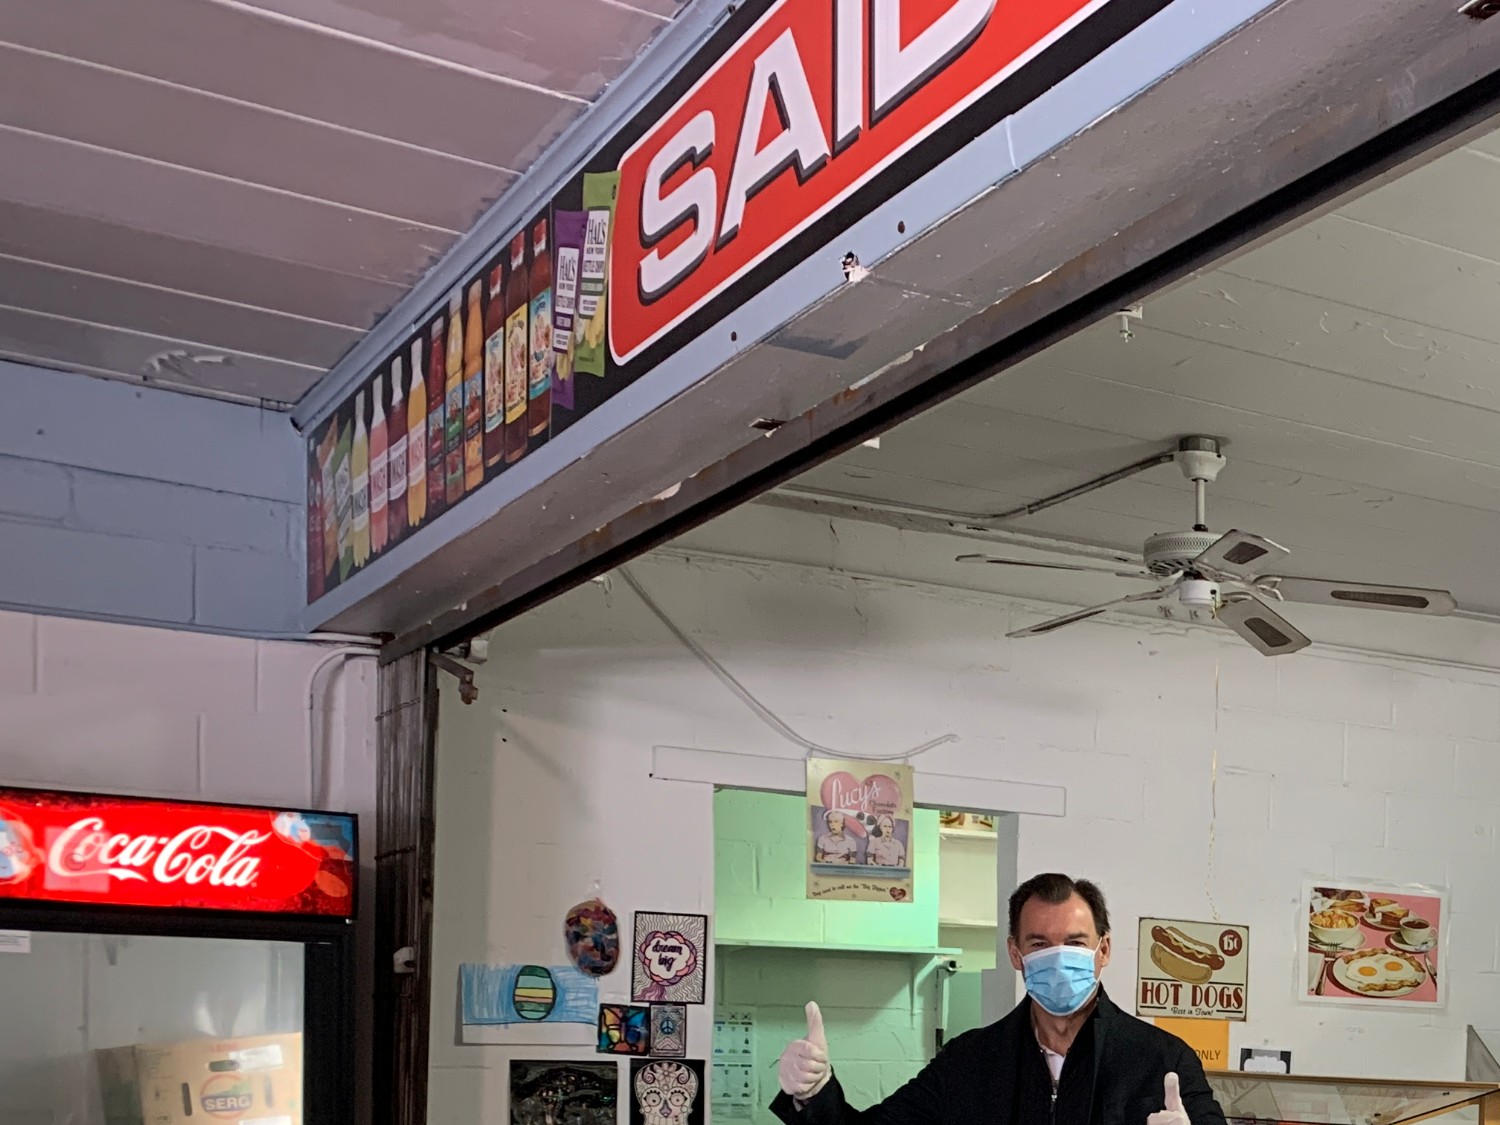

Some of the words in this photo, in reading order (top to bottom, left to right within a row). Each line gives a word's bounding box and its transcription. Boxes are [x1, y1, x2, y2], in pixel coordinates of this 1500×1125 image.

[50, 817, 272, 887] Coca-Cola
[652, 941, 683, 956] dream
[658, 954, 677, 971] big
[1141, 982, 1183, 1006] HOT
[1191, 984, 1243, 1009] DOGS
